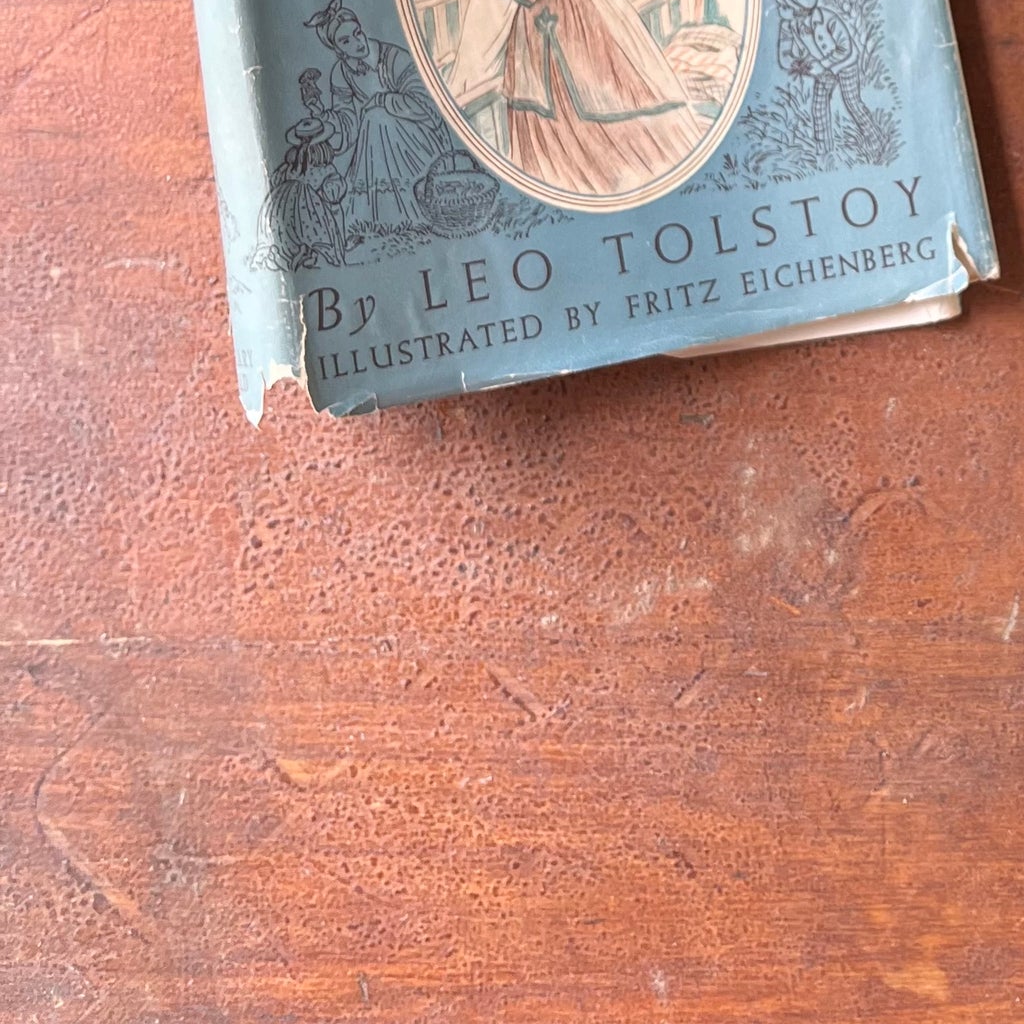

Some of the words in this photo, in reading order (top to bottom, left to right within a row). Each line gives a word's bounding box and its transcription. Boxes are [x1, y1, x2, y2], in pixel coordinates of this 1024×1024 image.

[308, 286, 376, 336] By
[418, 249, 553, 312] LEO
[603, 176, 921, 275] TOLSTOY
[318, 313, 543, 381] ILLUSTRATED
[565, 301, 601, 331] BY
[625, 278, 721, 319] FRITZ
[740, 236, 937, 296] EICHENBERG
